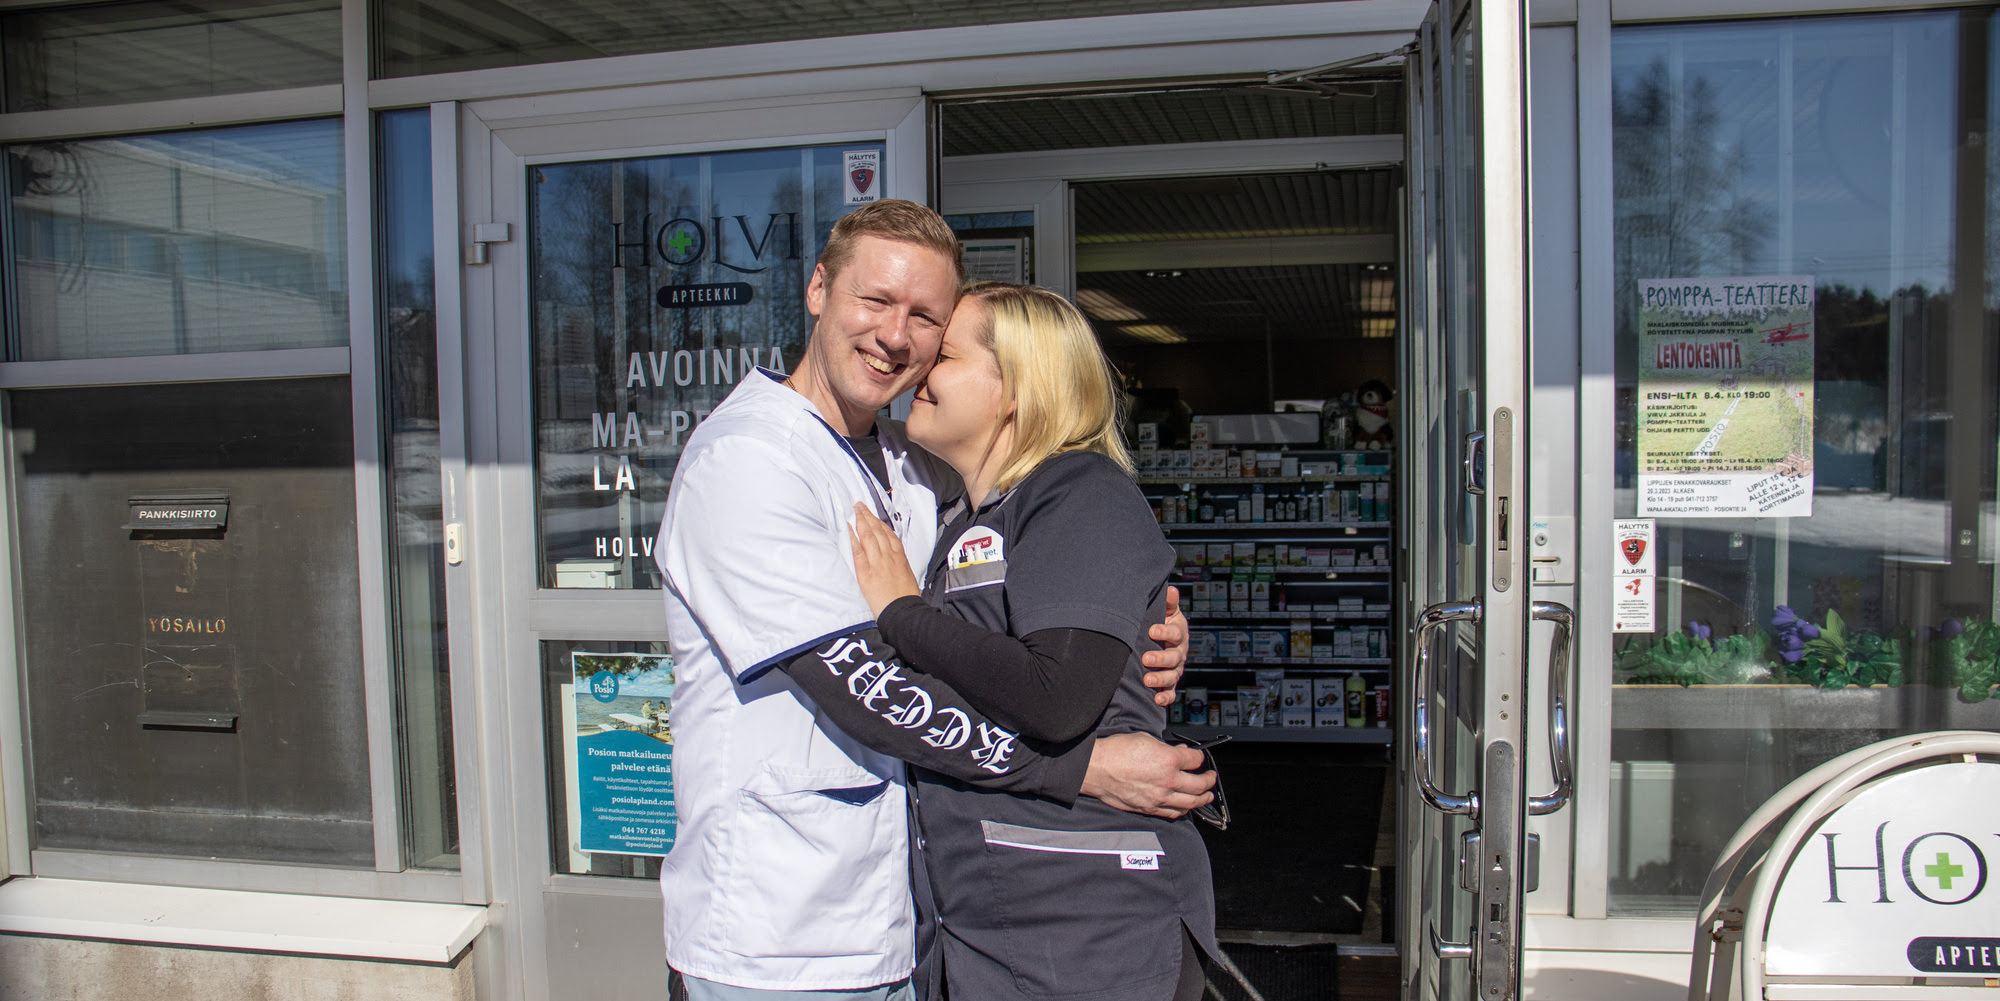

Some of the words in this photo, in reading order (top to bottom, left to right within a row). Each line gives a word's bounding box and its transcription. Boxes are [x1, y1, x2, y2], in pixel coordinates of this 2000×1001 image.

[848, 153, 876, 161] HÄLYTYS
[612, 212, 802, 274] HOLVI
[671, 288, 738, 304] APTEEKKI
[1647, 284, 1808, 307] POMPPA-TEATTERI
[1656, 338, 1742, 370] LENTOKENTTÄ
[626, 346, 786, 389] AVOINNA
[1647, 392, 1698, 400] ENSI-ILTA
[1744, 391, 1771, 399] 19:00
[593, 455, 636, 491] LA
[1747, 478, 1768, 493] LIPUT
[1749, 489, 1769, 502] ALLE
[1759, 489, 1805, 513] KORTTIMAKSU
[138, 509, 218, 520] PANKKISIIRTO
[595, 536, 654, 557] HOLV
[594, 683, 615, 694] Posio
[588, 748, 617, 757] Posion
[611, 762, 646, 773] palvelee
[647, 765, 671, 773] etänä
[611, 796, 675, 806] posiolapland.com
[621, 826, 635, 834] 044
[649, 828, 666, 836] 4218
[1819, 820, 2000, 905] HO
